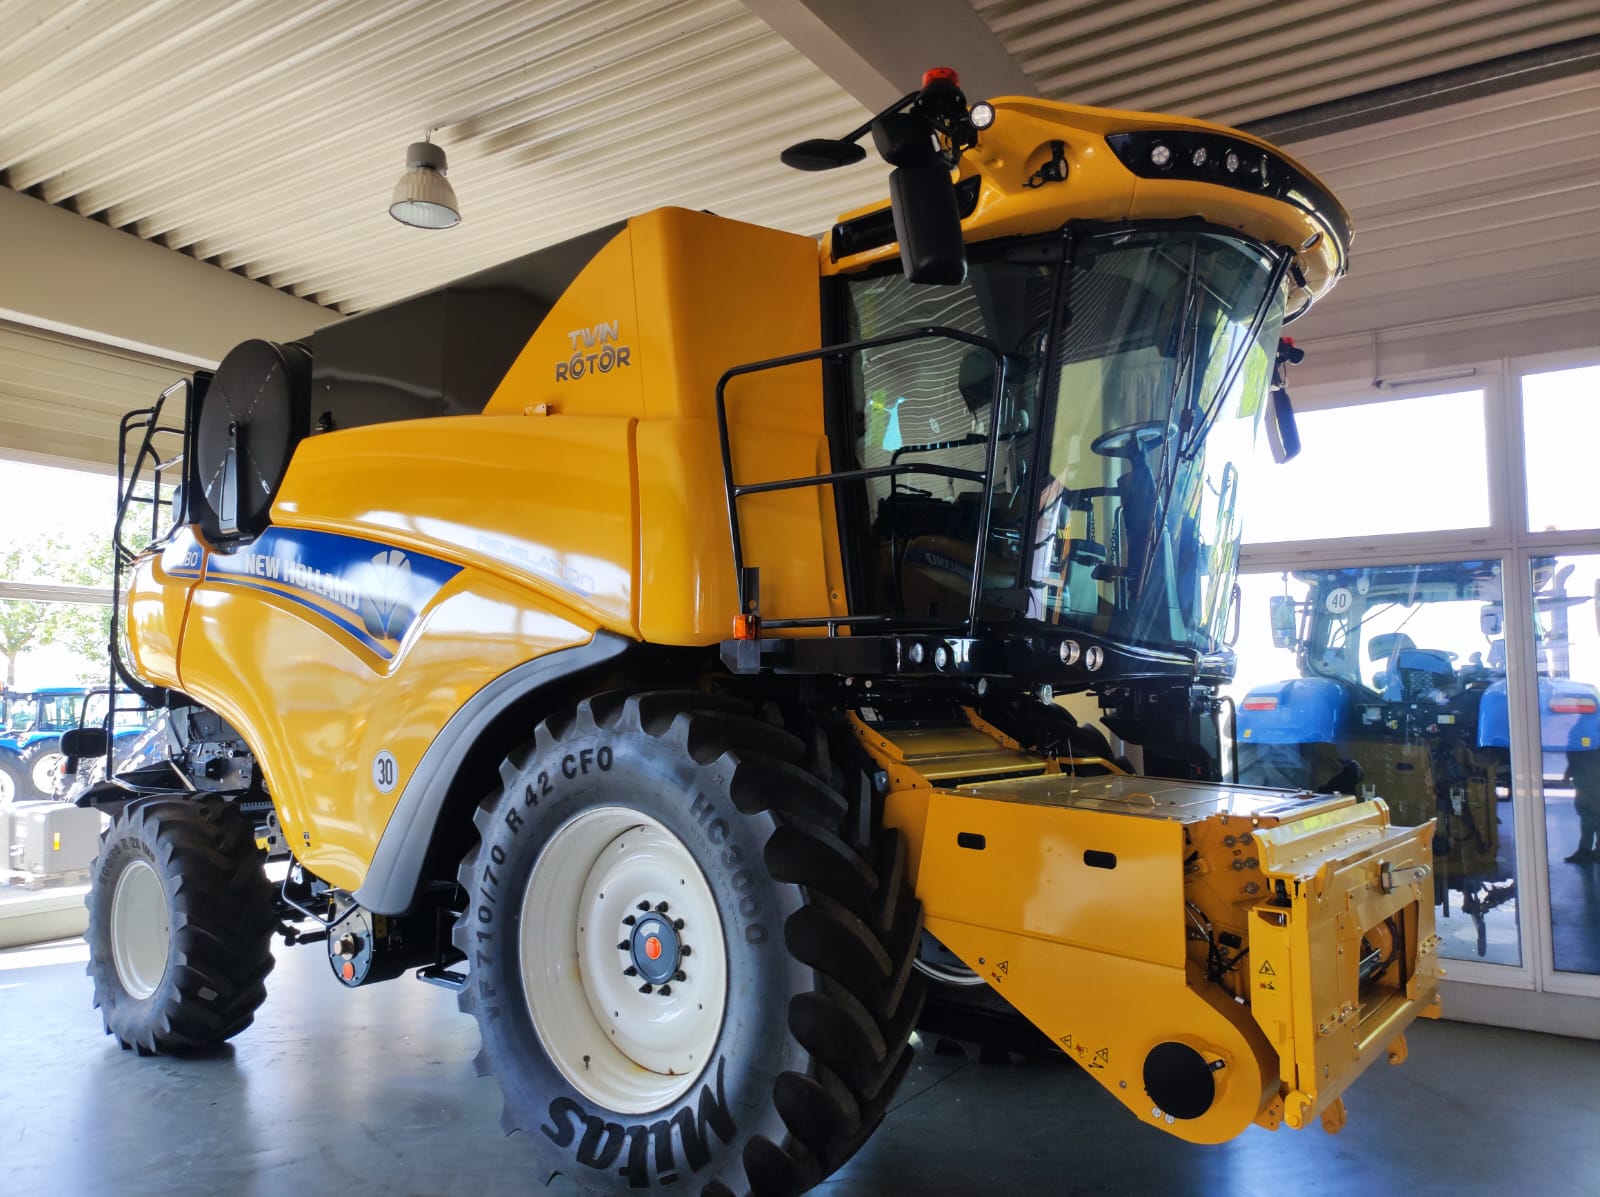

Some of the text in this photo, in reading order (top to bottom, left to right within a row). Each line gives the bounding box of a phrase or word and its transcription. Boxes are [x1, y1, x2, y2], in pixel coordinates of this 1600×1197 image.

[568, 319, 619, 351] TWIN
[555, 344, 631, 383] ROTOR
[244, 552, 361, 611] NEW HOLLAND
[1331, 593, 1347, 609] 40
[377, 758, 394, 786] 30
[475, 844, 507, 969] 710/70
[504, 807, 525, 836] R
[525, 770, 554, 809] 42
[561, 745, 614, 780] CFO
[540, 1053, 737, 1189] Mitas
